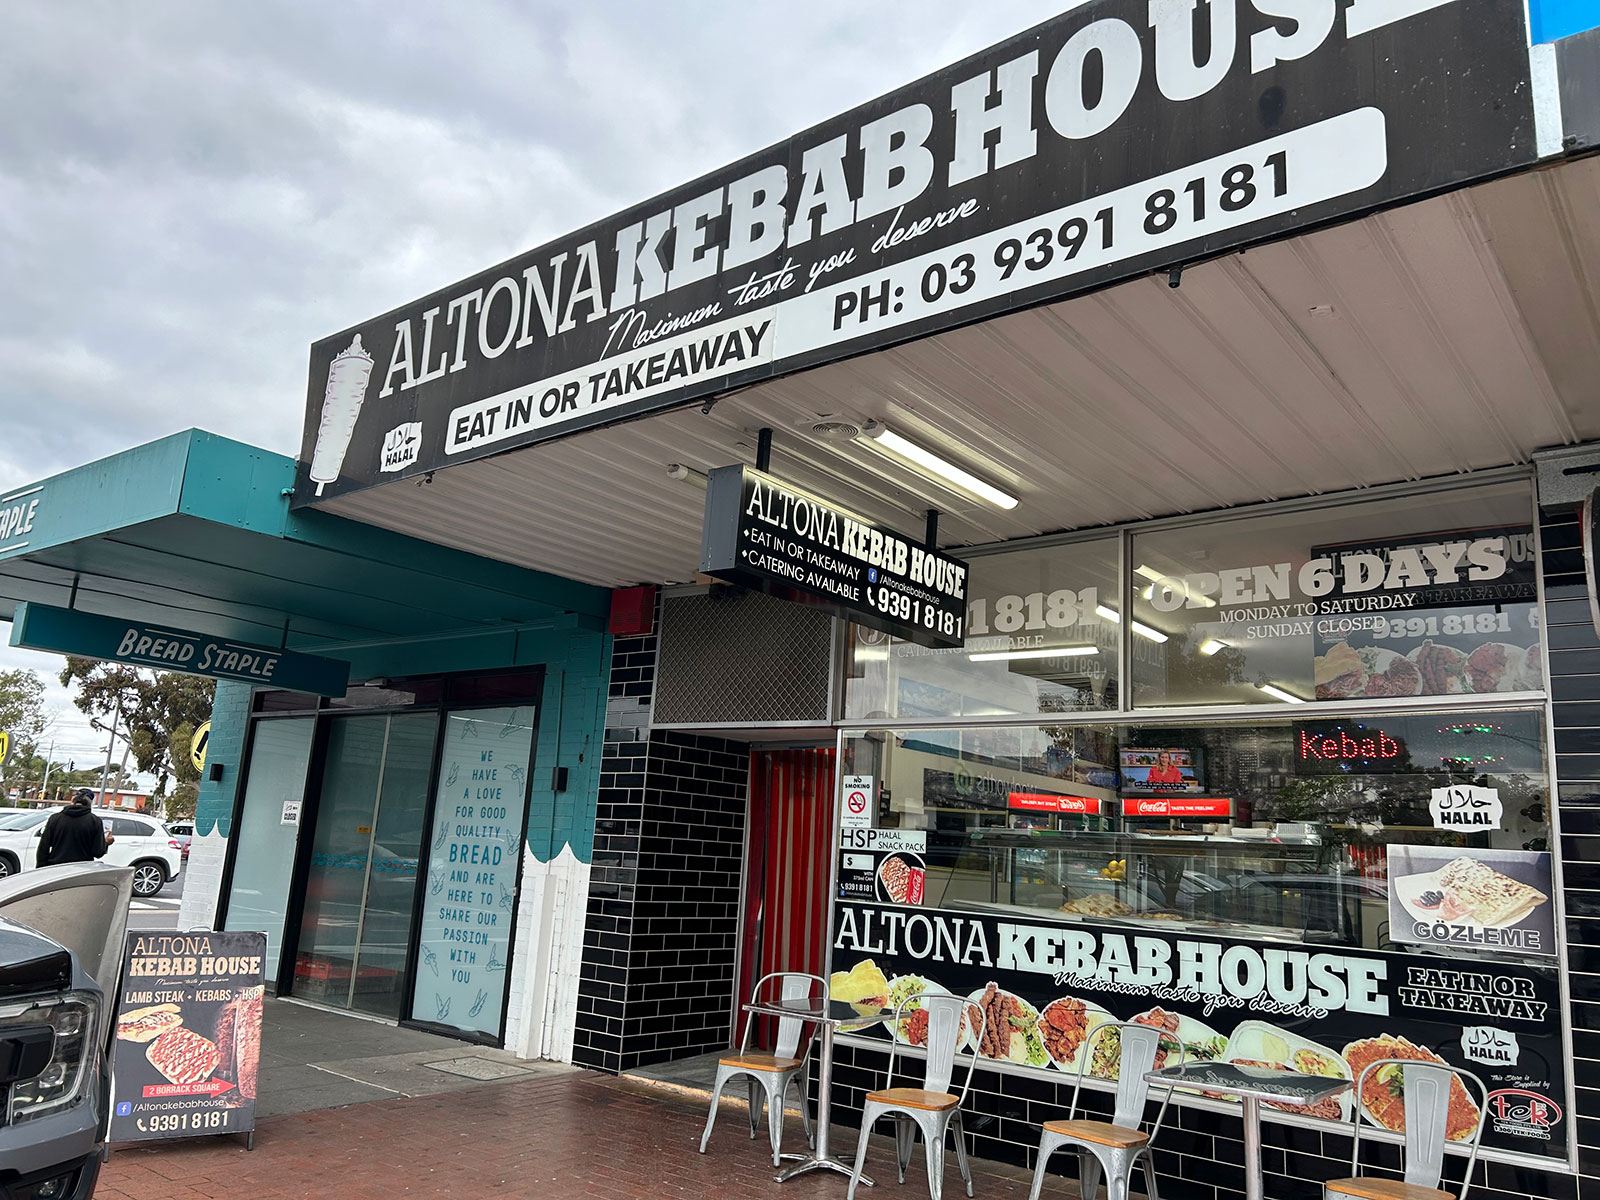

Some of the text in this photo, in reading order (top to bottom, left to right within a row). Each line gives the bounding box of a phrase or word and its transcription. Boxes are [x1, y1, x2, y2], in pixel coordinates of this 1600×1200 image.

[379, 0, 1460, 399] ALTONA KEBAB HOUS
[600, 196, 982, 362] Maximum taste you deserve
[453, 149, 1288, 446] EAT IN OR TAKEAWAY PH: 03 9391 8181
[385, 447, 414, 467] HALAL
[745, 478, 966, 600] ALTONA KEBAB HOUSE
[750, 527, 861, 581] EAT IN OR TAKEAWAY
[748, 550, 860, 602] CATERING AVAILABLE
[1150, 562, 1292, 612] OPEN
[1299, 558, 1336, 597] 6
[1341, 538, 1507, 594] DAYS
[1426, 581, 1538, 604] TAKEAWA
[877, 587, 920, 624] 9391
[923, 604, 962, 639] 8181
[994, 586, 1100, 633] 8181
[1219, 604, 1292, 624] MONDAY
[1293, 602, 1319, 617] TO
[1320, 592, 1418, 615] SATURDAY
[1246, 621, 1315, 639] SUNDAY
[1316, 615, 1387, 635] CLOSED
[1372, 616, 1440, 640] 9391
[1442, 611, 1512, 635] 8181
[116, 628, 279, 677] BREAD STAPLE
[480, 750, 494, 762] WE
[472, 769, 497, 781] HAVE
[853, 776, 863, 784] NO
[463, 787, 502, 800] A LOVE
[1438, 789, 1492, 809] حلال
[455, 806, 507, 819] FOR GOOD
[1440, 811, 1493, 825] HALAL
[455, 824, 501, 839] QUALITY
[840, 828, 877, 848] HSP
[879, 831, 902, 840] HALAL
[449, 843, 502, 866] BREAD
[878, 841, 925, 852] SNACK PACK
[847, 857, 853, 866] $
[450, 870, 495, 886] AND ARE
[447, 889, 493, 905] HERE TO
[439, 907, 497, 926] SHARE OUR
[443, 927, 489, 946] PASSION
[1412, 920, 1542, 950] GÖZLEME
[131, 936, 213, 956] ALTONA
[450, 948, 477, 964] WITH
[129, 956, 261, 977] KEBAB HOUSE
[833, 907, 1390, 1017] ALTONA KEBAB HOUSE
[451, 968, 471, 984] YOU
[1407, 966, 1536, 999] EAT IN OR
[125, 988, 260, 1004] LAMB STEAK KEBABS HSP
[1053, 970, 1329, 1020] Maximum taste you deserve
[1398, 986, 1548, 1022] TAKEAWAY
[1468, 1029, 1512, 1046] حلال
[1469, 1046, 1512, 1062] HALAL
[149, 1082, 221, 1095] 2 BORRACK SQUARE
[132, 1099, 225, 1113] /Altonakebabhouse
[149, 1110, 229, 1132] 9391 8181
